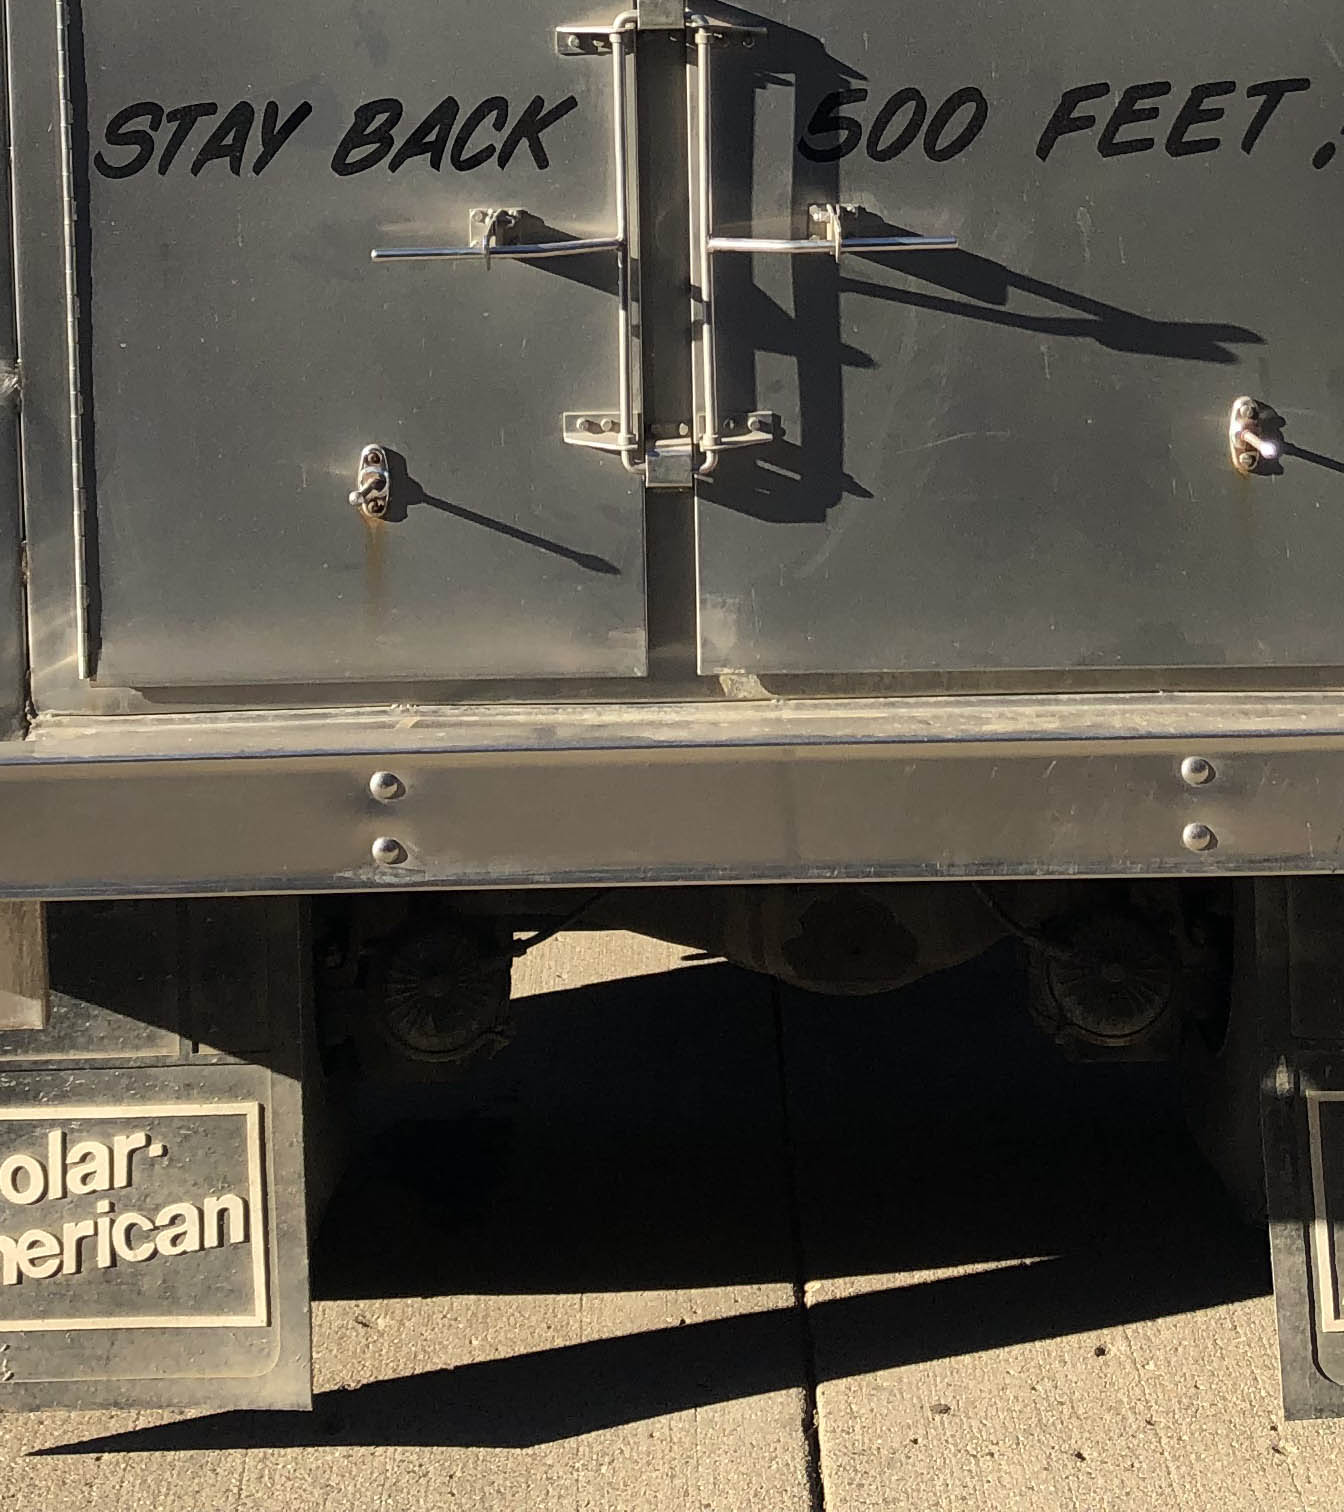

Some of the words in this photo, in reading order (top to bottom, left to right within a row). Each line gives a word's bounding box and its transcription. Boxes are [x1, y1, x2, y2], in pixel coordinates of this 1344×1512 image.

[93, 97, 312, 179] STAY
[330, 95, 578, 177] BACK
[797, 87, 989, 163] 500
